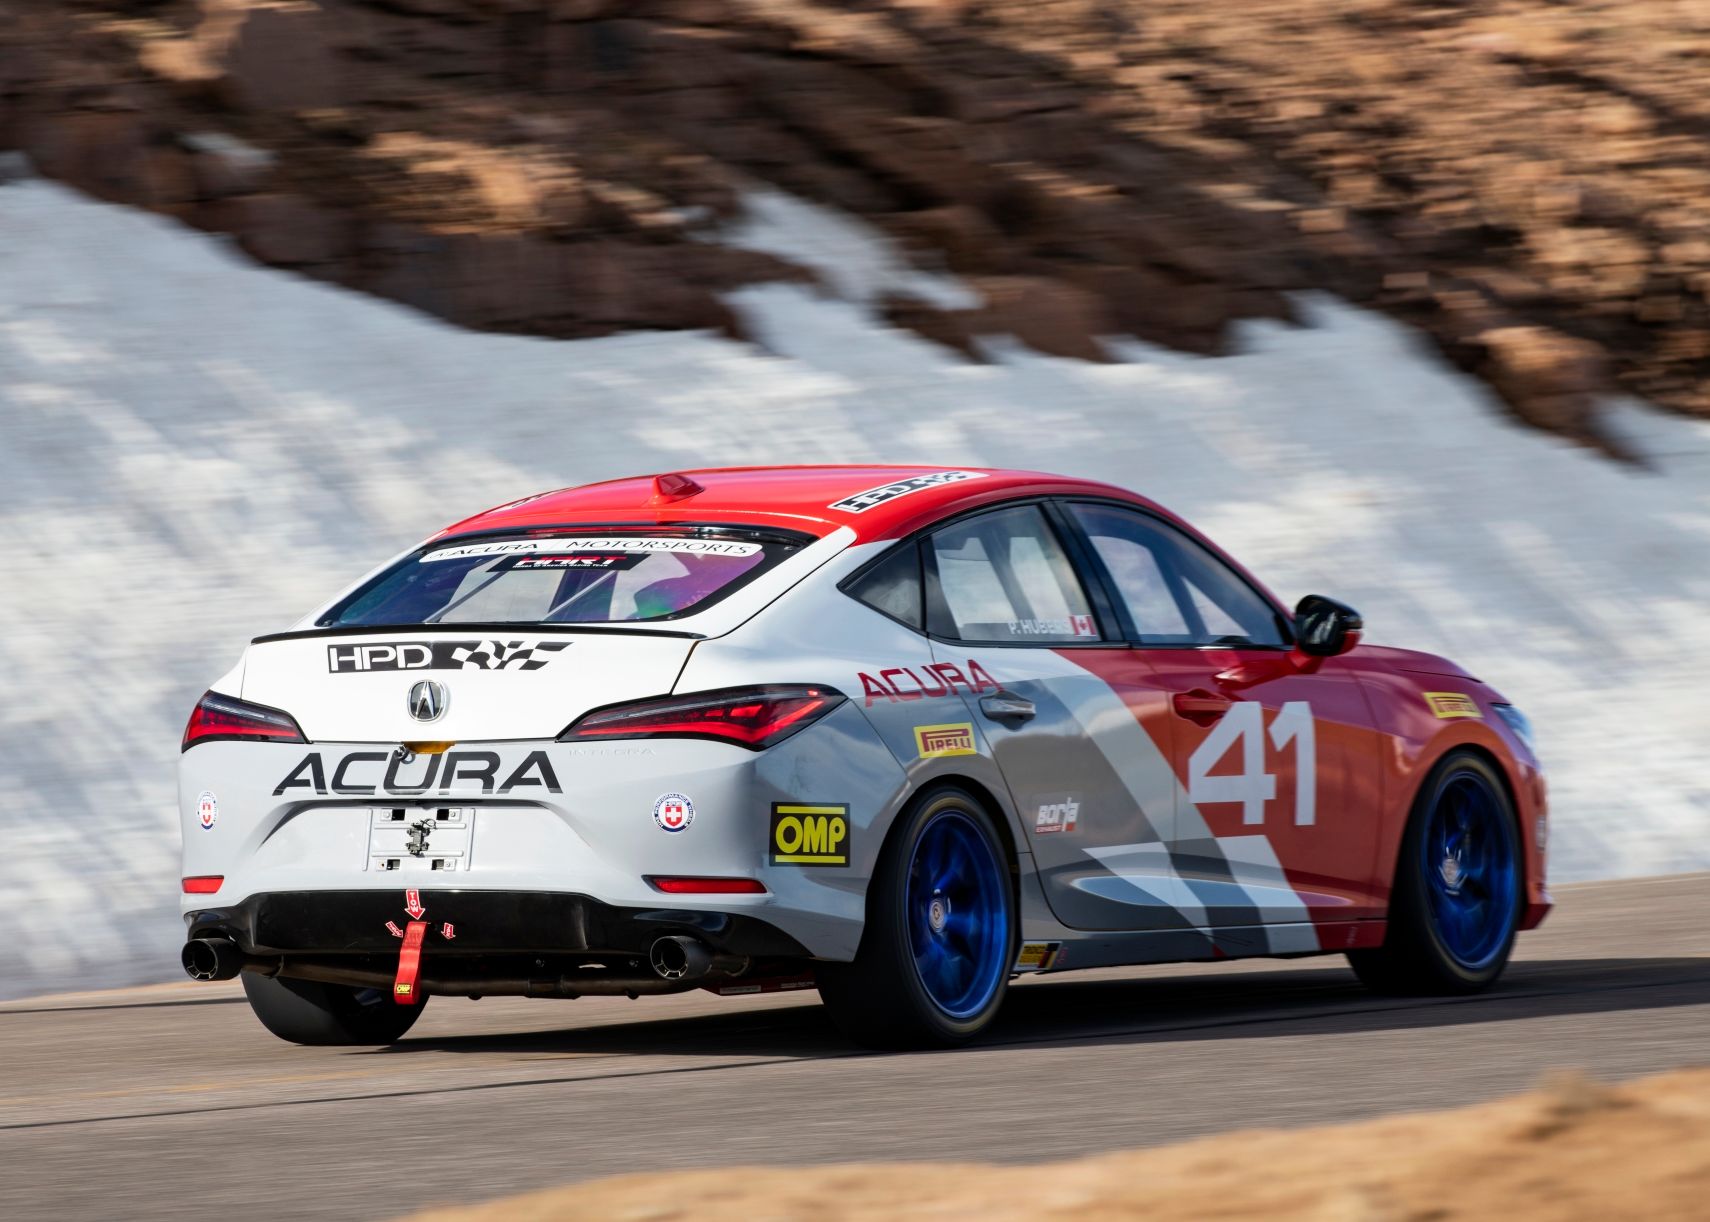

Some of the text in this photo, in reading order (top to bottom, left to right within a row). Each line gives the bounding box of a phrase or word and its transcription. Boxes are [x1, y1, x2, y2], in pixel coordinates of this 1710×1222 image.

[447, 540, 752, 556] ACURA MOTORSPORTS
[515, 555, 628, 566] HART
[329, 644, 432, 671] HPD
[856, 659, 1006, 707] ACURA
[920, 728, 972, 752] PIRELLI
[272, 750, 563, 796] ACURA
[1188, 701, 1317, 826] 41
[775, 815, 846, 854] OMP
[410, 892, 419, 913] TOW
